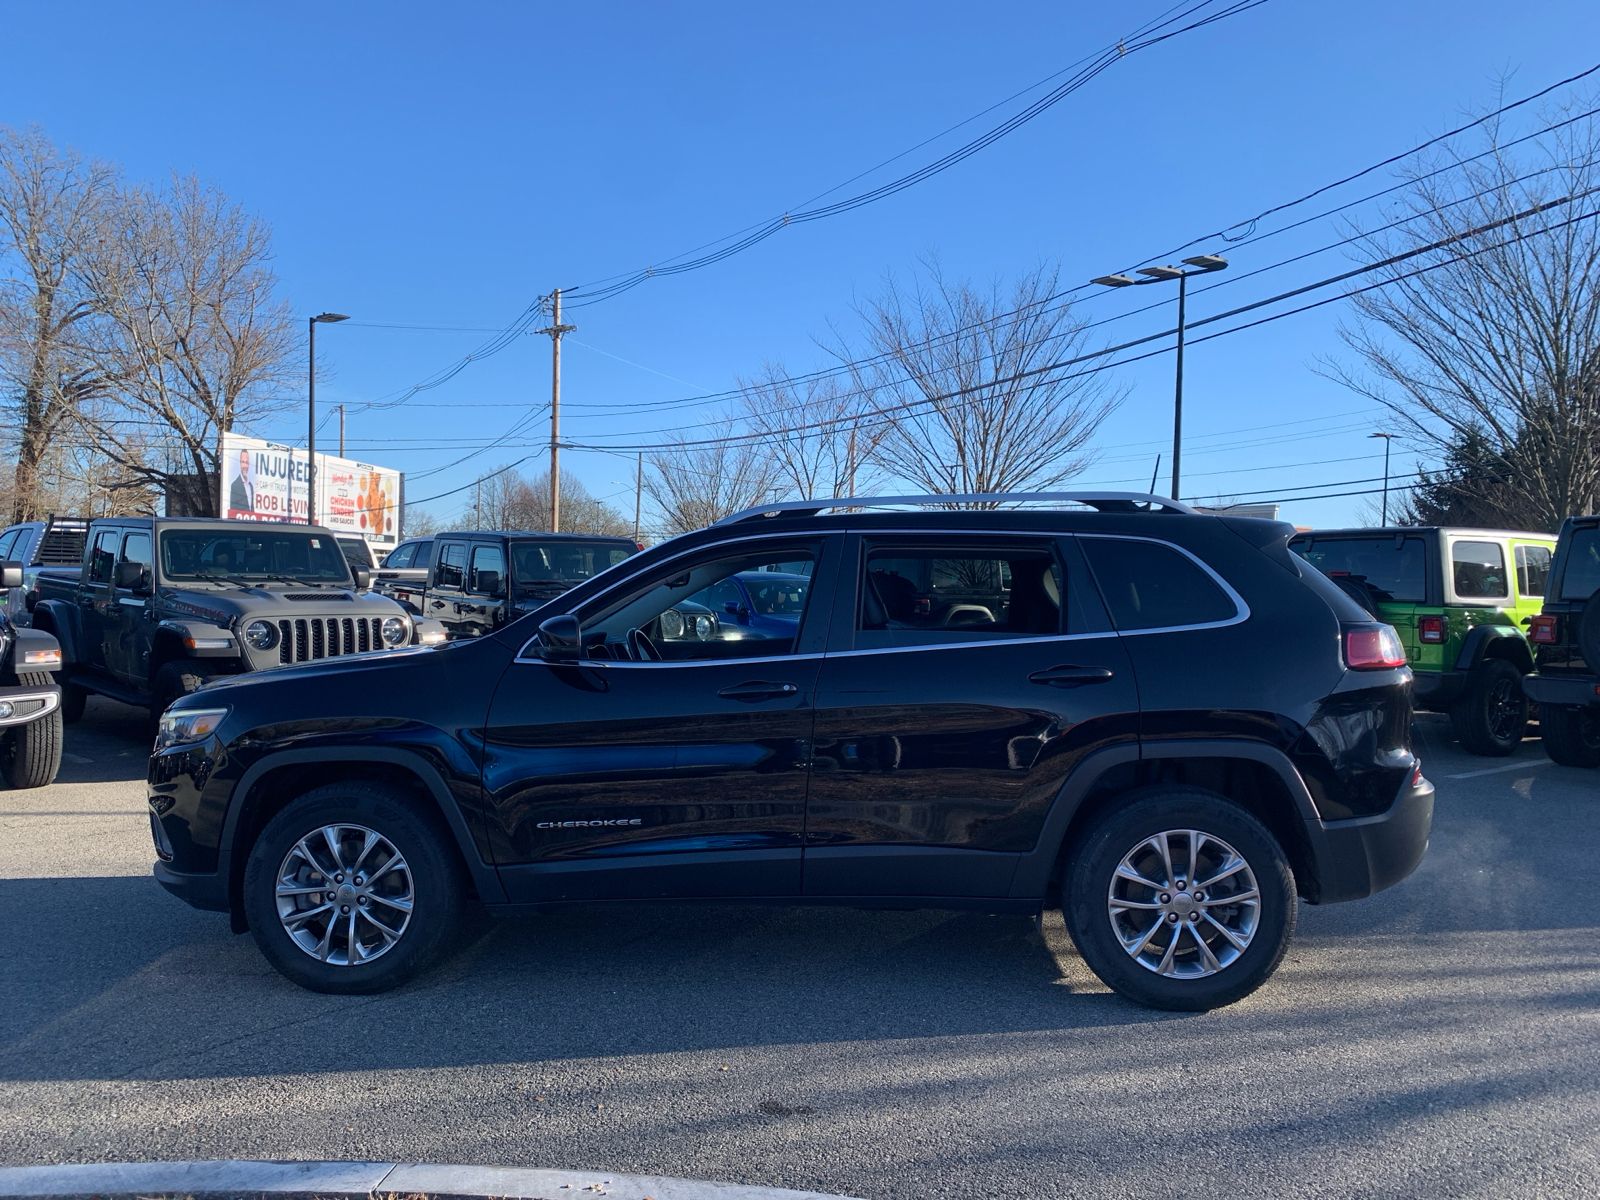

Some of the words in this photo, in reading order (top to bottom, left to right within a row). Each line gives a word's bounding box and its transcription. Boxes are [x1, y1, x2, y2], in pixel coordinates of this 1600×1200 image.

[255, 493, 278, 510] ROB
[330, 496, 355, 507] CHICKEN
[329, 506, 354, 517] TENDERS
[329, 516, 339, 524] AND
[339, 517, 354, 525] SAUCES
[536, 818, 642, 829] CHEROKEE
